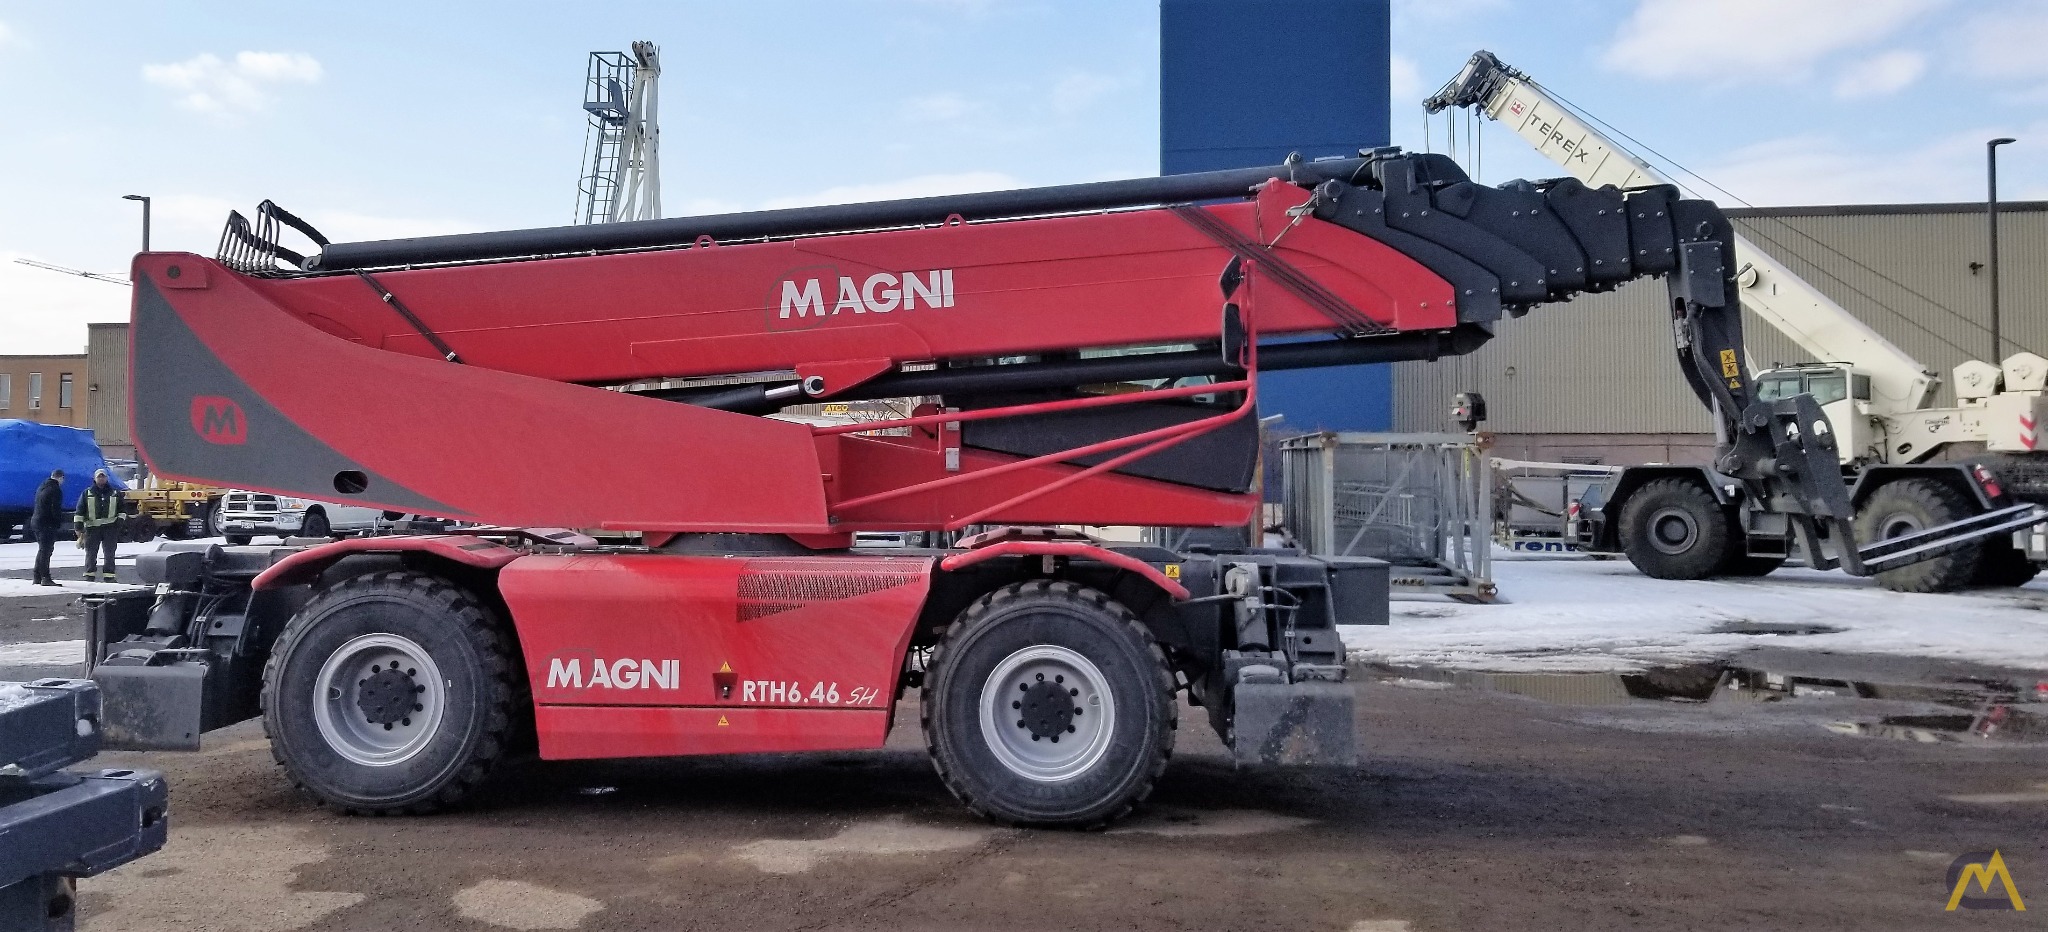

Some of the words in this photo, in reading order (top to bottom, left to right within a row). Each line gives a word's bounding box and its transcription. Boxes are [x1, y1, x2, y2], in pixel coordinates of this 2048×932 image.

[1530, 113, 1589, 163] TEREX
[779, 269, 955, 319] MAGNI
[203, 405, 238, 436] M
[824, 404, 849, 413] ATCO
[546, 657, 680, 690] MAGNI
[743, 680, 840, 704] RTH6.46
[845, 686, 879, 705] SH
